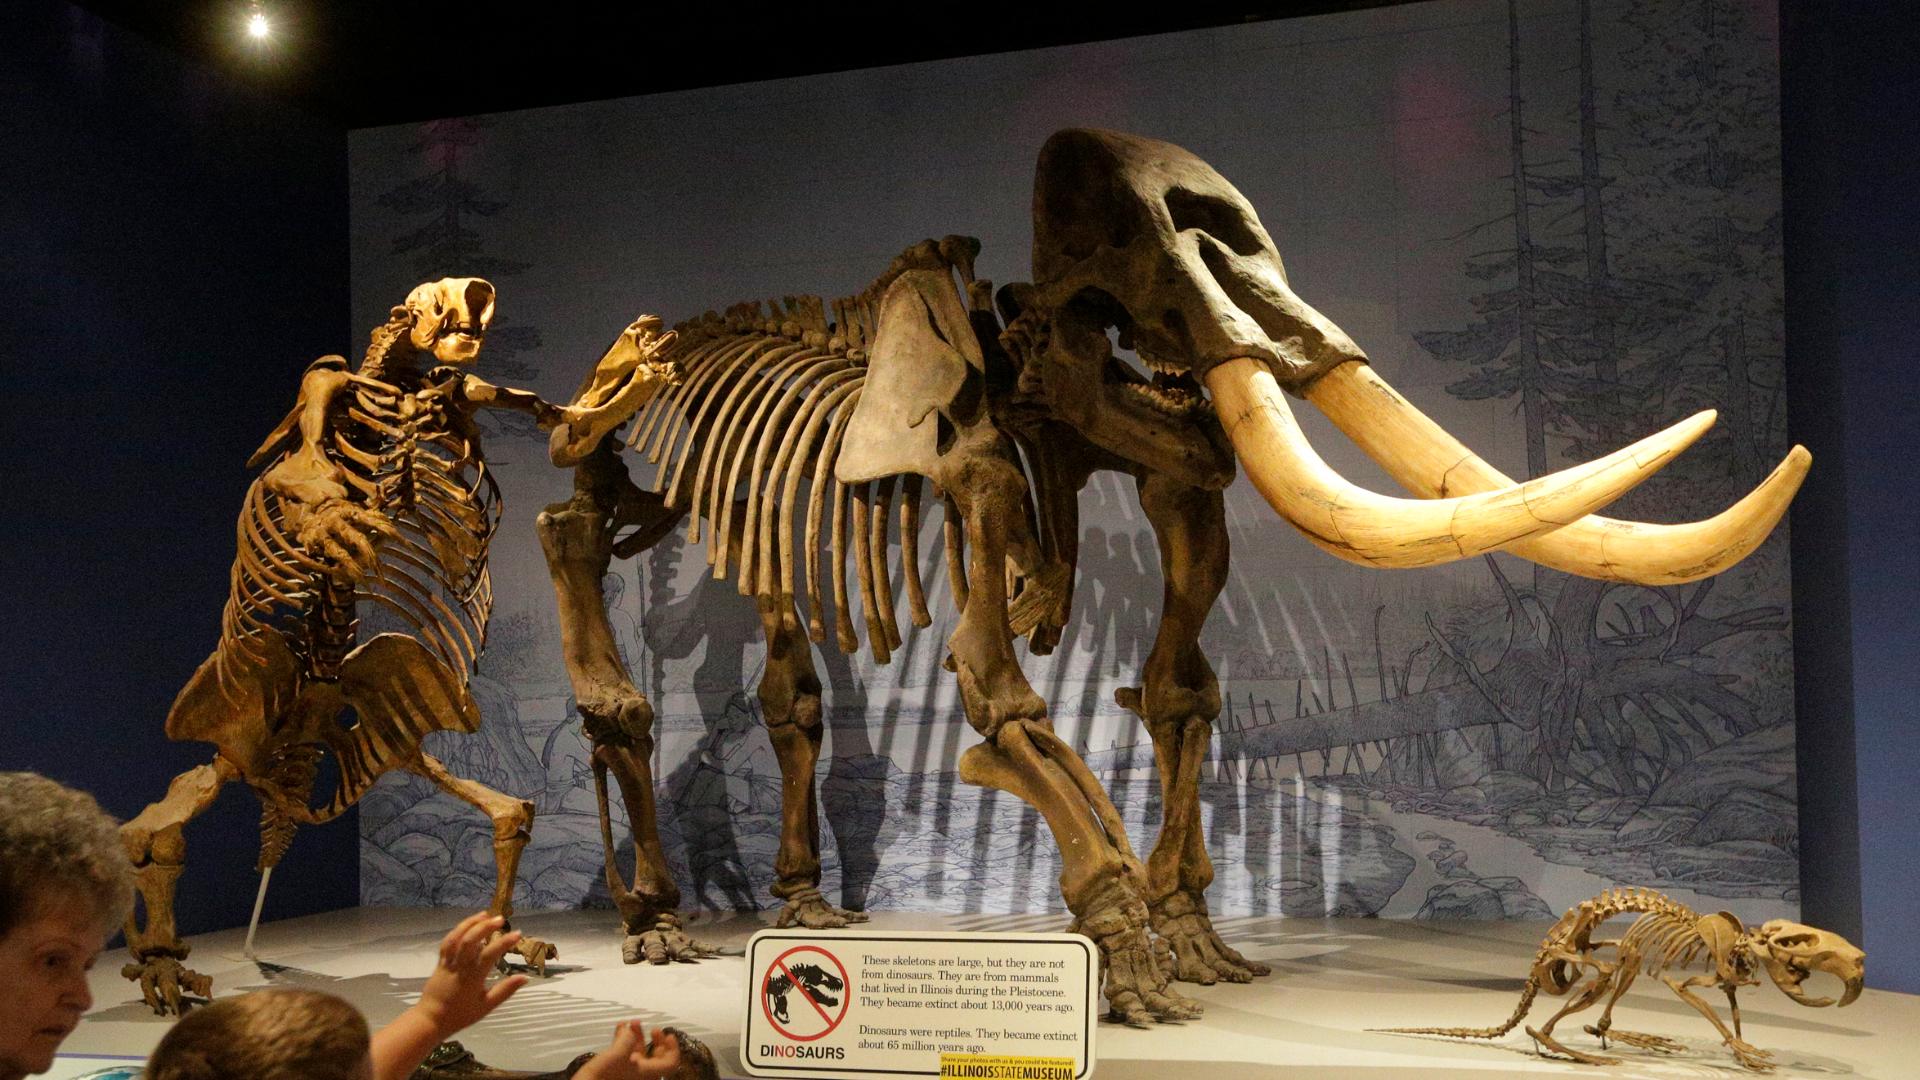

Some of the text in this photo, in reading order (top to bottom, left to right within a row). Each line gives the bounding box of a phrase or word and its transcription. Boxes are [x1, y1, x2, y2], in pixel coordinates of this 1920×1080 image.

[862, 955, 890, 965] These
[892, 956, 936, 967] skeletons
[957, 957, 984, 969] large,
[987, 957, 1002, 967] but
[1006, 957, 1027, 970] they
[1049, 960, 1065, 969] not
[861, 969, 883, 979] from
[886, 969, 935, 980] dinosaurs.
[938, 970, 962, 983] They
[984, 972, 1006, 981] from
[1010, 973, 1059, 983] mammals
[861, 983, 1066, 997] that lived in Illinois during the Pleistocene.
[860, 997, 1074, 1014] They became extinct about 13,000 years ago.
[859, 1024, 907, 1036] Dinosaurs
[935, 1028, 972, 1039] reptiles.
[976, 1028, 1000, 1041] They
[1003, 1029, 1040, 1040] became
[1043, 1030, 1078, 1041] extinct
[760, 1044, 845, 1060] DINOSAURS
[858, 1039, 986, 1054] about 65 million years ago.
[941, 1064, 1073, 1080] #ILLINOISSTATEMUSEUM
